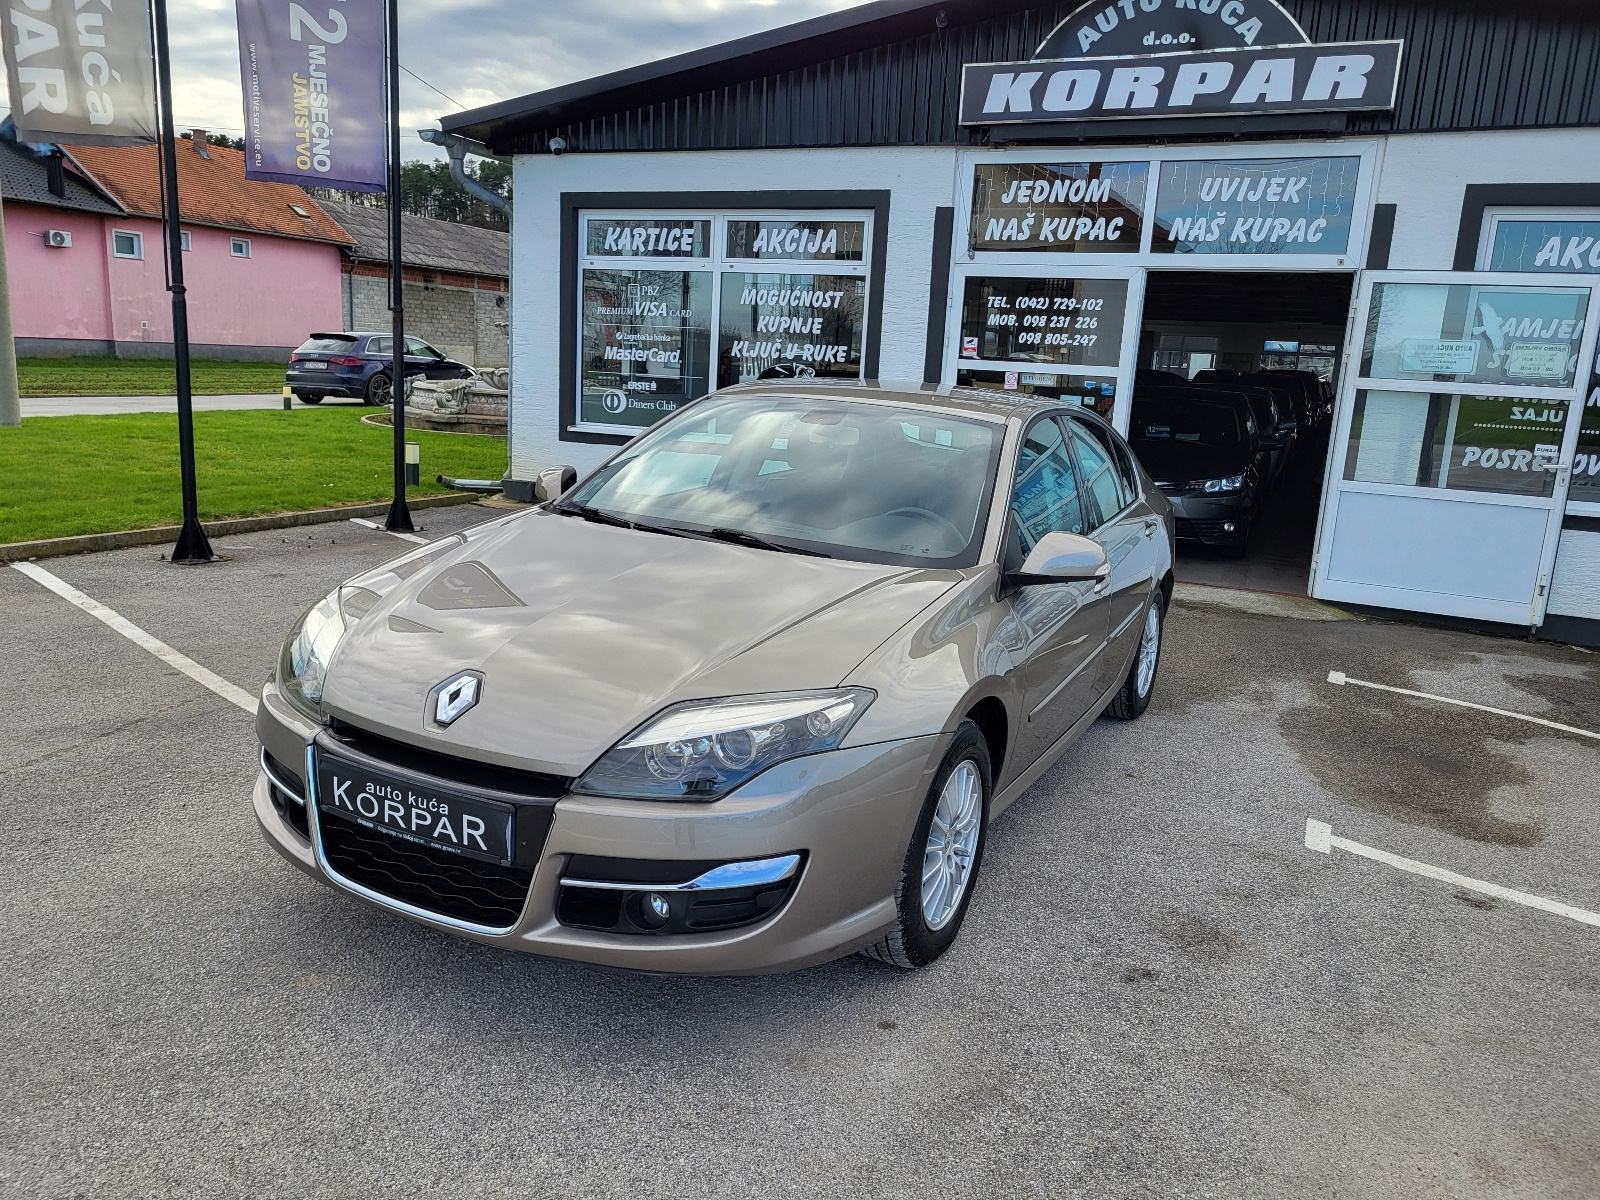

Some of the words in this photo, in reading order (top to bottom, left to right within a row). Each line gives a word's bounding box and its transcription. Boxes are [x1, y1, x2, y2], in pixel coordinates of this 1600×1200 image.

[289, 0, 348, 45] 2
[1076, 0, 1163, 53] AUTO
[1142, 31, 1196, 46] d.o.o.
[981, 54, 1375, 114] KORPAR
[249, 43, 263, 167] www.motiveservice.eu
[308, 44, 333, 173] MJESEČNO
[292, 72, 311, 171] JAMSTVO
[1001, 178, 1112, 205] JEDNOM
[1199, 176, 1308, 203] UVIJEK
[604, 226, 695, 252] KARTICE
[984, 212, 1036, 242] NAŠ
[1038, 215, 1124, 243] KUPAC
[1168, 212, 1228, 243] NAŠ
[1229, 215, 1327, 245] KUPAC
[752, 228, 838, 254] AKCIJA
[641, 285, 660, 296] PBZ
[740, 284, 844, 308] MOGUĆNOST
[987, 296, 1010, 309] TEL.
[1015, 296, 1049, 310] (042)
[1053, 297, 1104, 311] 729-102
[596, 306, 634, 316] PREMIUM
[634, 301, 667, 317] VISA
[669, 309, 693, 318] CARD
[987, 314, 1019, 327] MOB.
[1023, 315, 1047, 328] 098
[1049, 315, 1071, 328] 231
[1075, 316, 1098, 329] 226
[653, 333, 671, 342] banka
[756, 315, 824, 335] KUPNJE
[1497, 316, 1584, 340] AMJE
[730, 338, 782, 359] KLJUČ
[786, 343, 799, 360] U
[802, 343, 848, 363] RUKE
[1018, 332, 1042, 345] 098
[1045, 333, 1098, 347] 805-247
[628, 381, 651, 391] ERSTE
[628, 398, 655, 410] Diners
[656, 400, 676, 411] Club
[366, 781, 402, 801] auto
[408, 792, 449, 815] kuća
[332, 776, 488, 851] KORPAR
